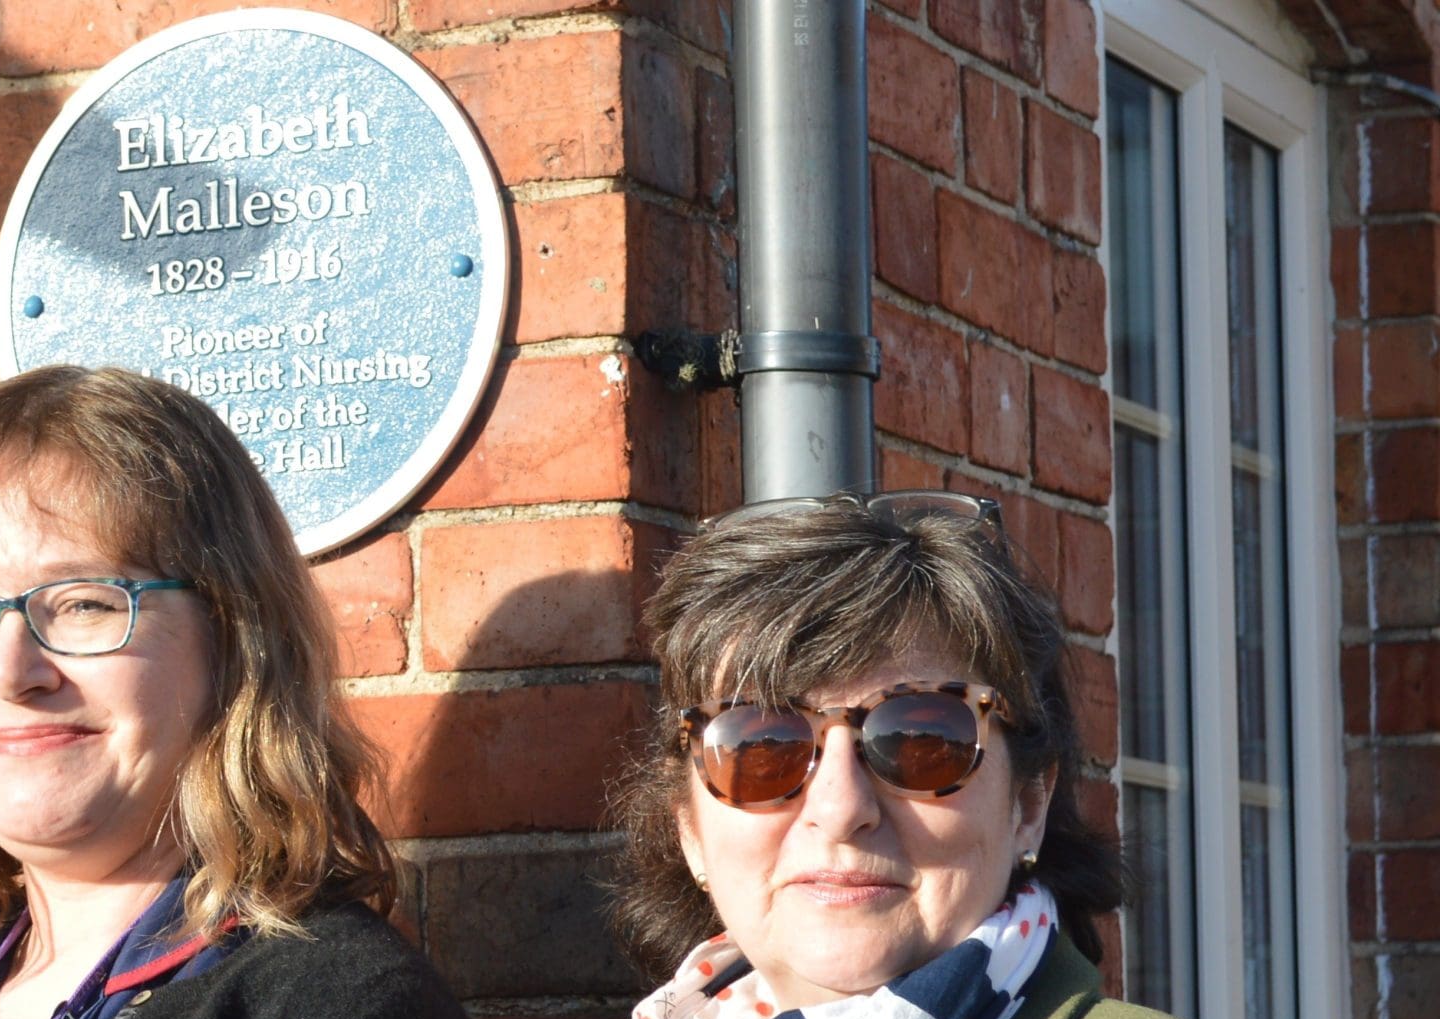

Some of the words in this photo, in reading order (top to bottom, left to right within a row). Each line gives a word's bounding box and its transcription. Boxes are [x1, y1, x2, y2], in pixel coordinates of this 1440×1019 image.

[113, 96, 374, 172] Elizabeth
[119, 178, 371, 240] Malleson
[147, 256, 225, 296] 1828
[260, 242, 342, 285] 1916
[161, 325, 286, 359] Pioneer
[294, 311, 329, 346] of
[162, 361, 285, 397] District
[292, 348, 432, 388] Nursing
[271, 396, 308, 431] of
[315, 394, 368, 427] the
[269, 434, 345, 473] Hall
